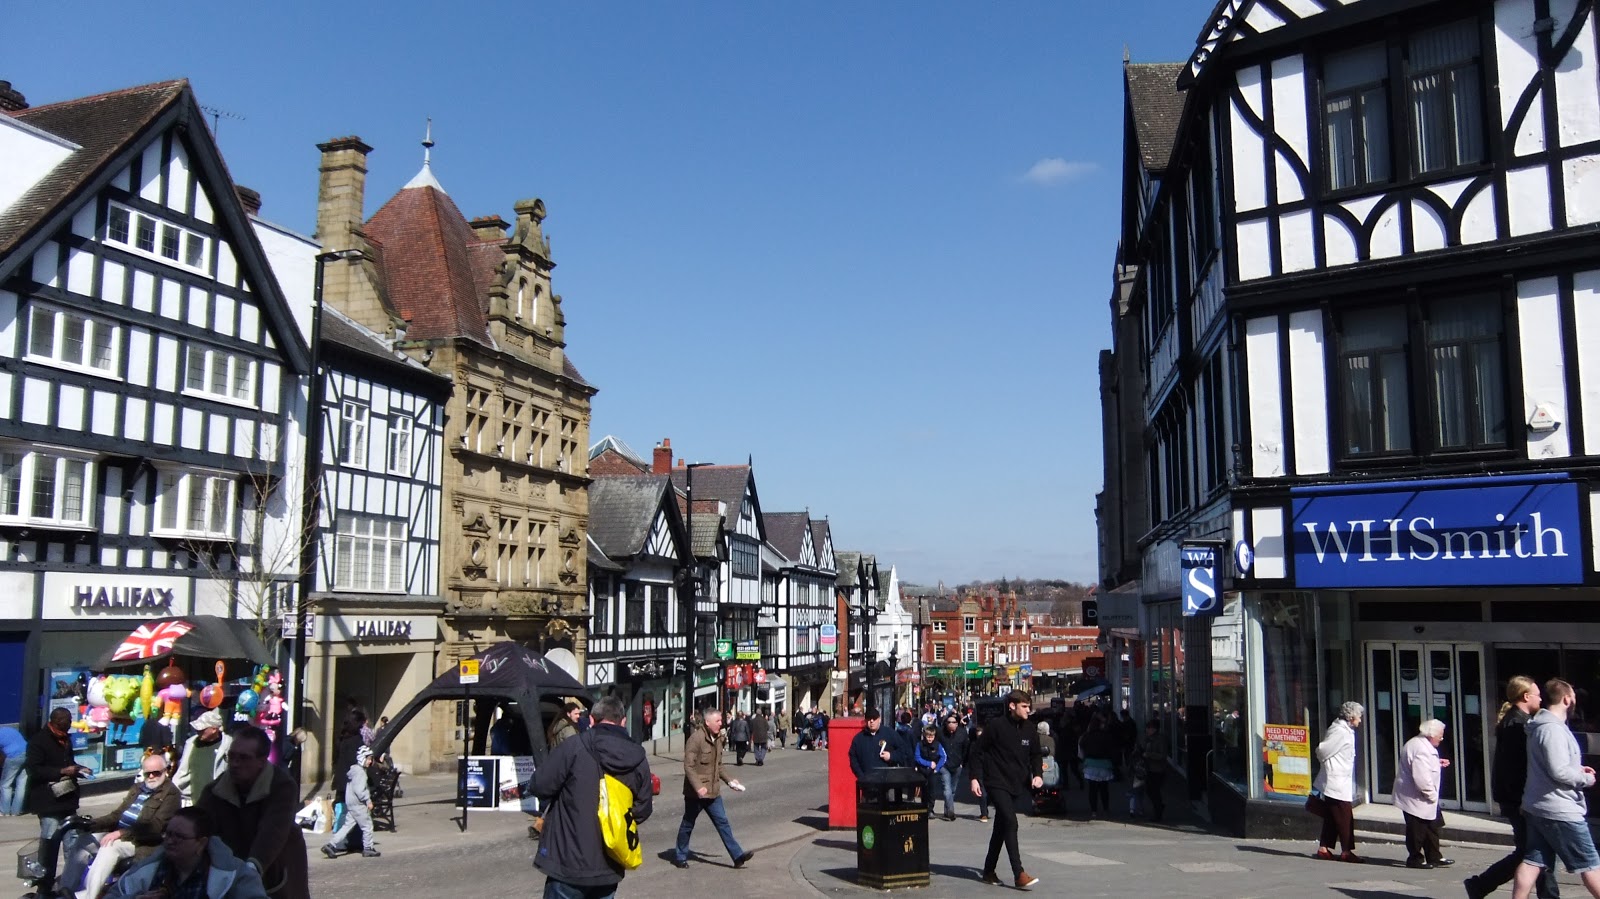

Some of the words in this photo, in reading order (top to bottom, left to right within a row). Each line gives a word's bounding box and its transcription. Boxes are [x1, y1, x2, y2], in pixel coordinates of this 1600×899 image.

[1303, 512, 1568, 563] WHSmith
[1187, 552, 1215, 565] WH
[73, 585, 174, 608] HALIFAX
[1188, 567, 1216, 610] S
[356, 620, 412, 636] HALIFAX
[1267, 734, 1304, 742] SOMETHING?
[896, 814, 919, 823] LITTER
